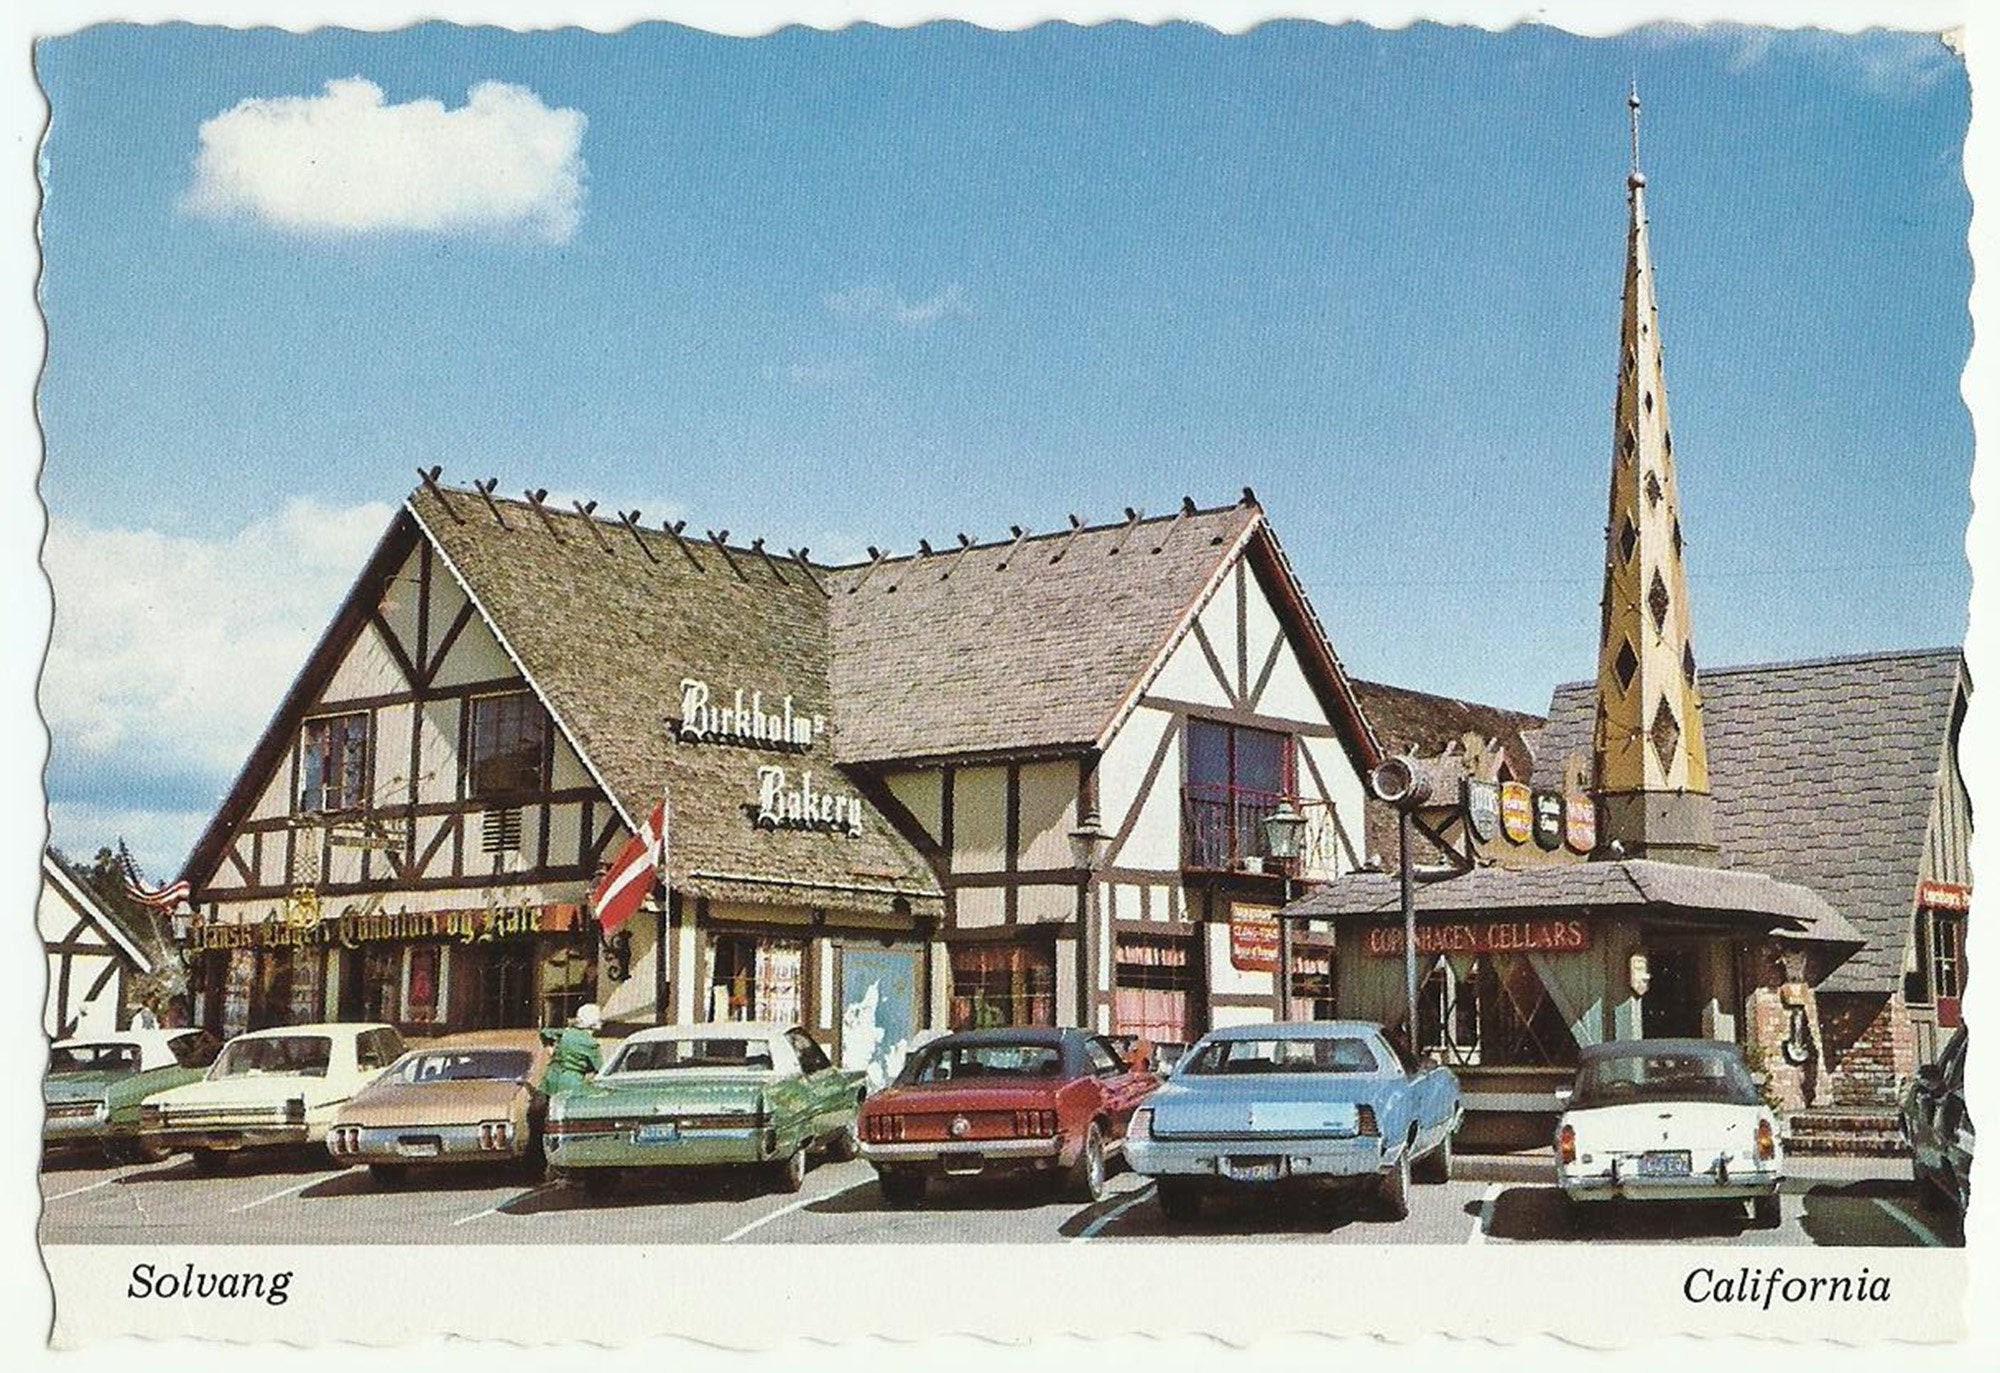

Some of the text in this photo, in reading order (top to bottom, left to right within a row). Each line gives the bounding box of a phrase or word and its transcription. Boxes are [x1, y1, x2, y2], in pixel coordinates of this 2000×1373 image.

[757, 764, 862, 838] Bakery
[447, 911, 474, 945] og
[1487, 920, 1582, 949] CELLARS
